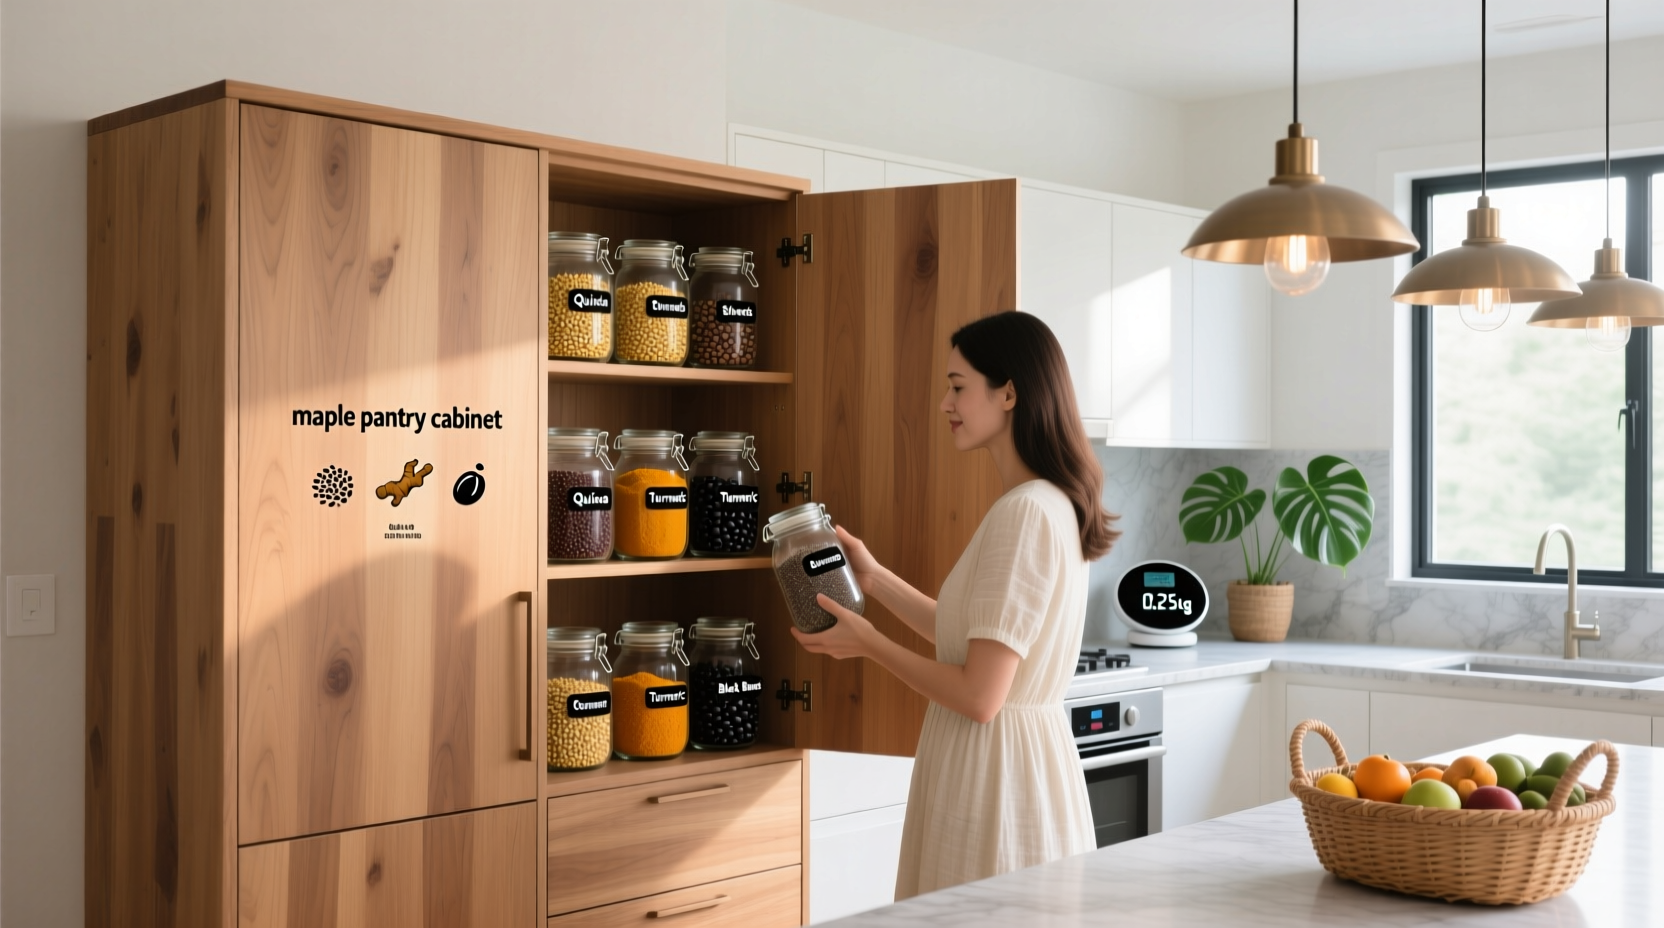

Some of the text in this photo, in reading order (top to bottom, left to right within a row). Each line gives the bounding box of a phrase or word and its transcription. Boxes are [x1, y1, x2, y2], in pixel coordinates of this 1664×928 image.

[292, 403, 503, 434] maple pantry cabinet
